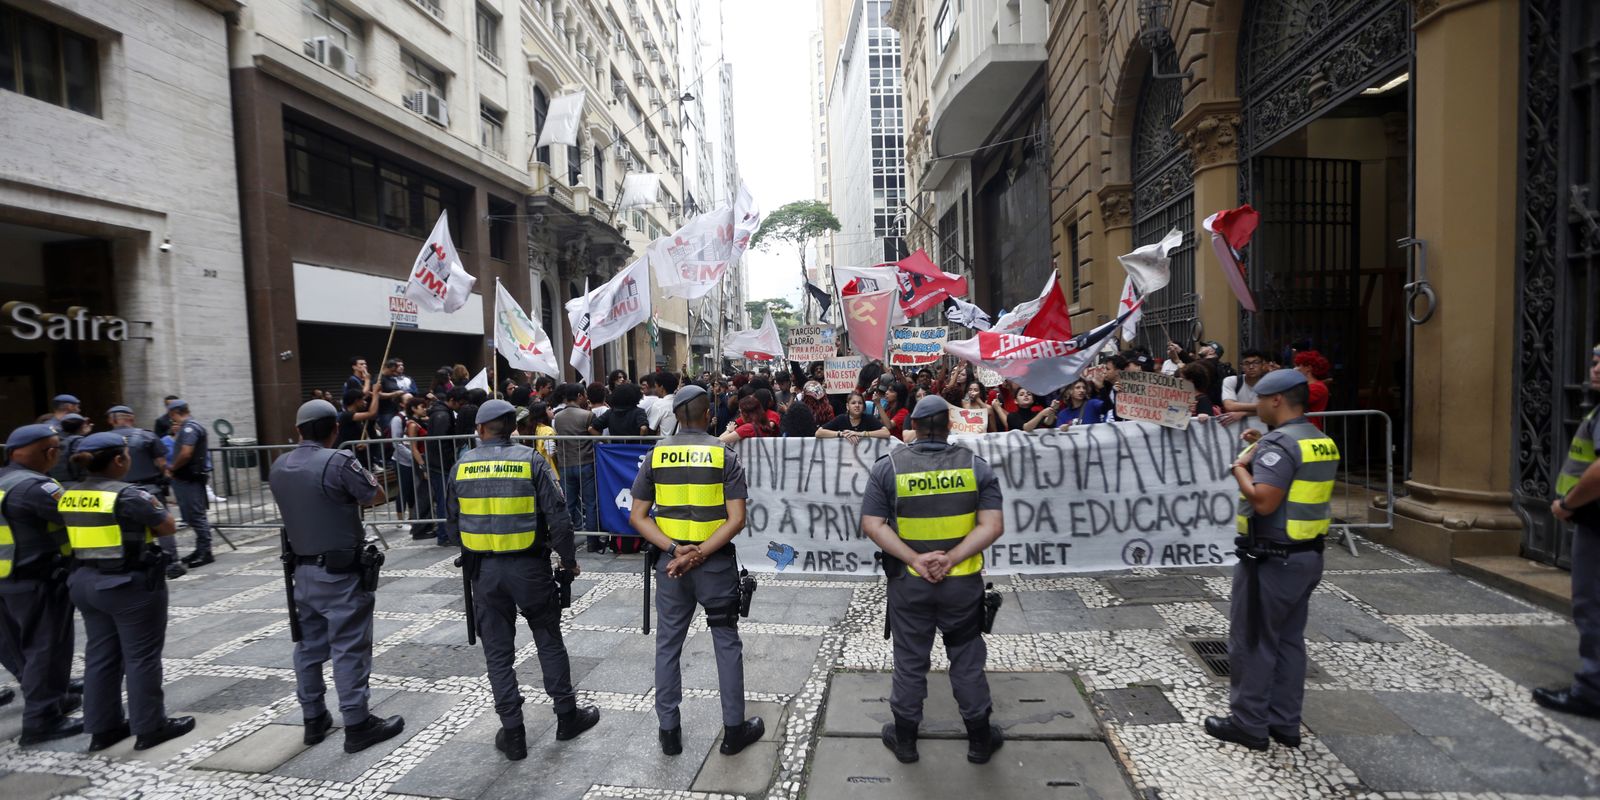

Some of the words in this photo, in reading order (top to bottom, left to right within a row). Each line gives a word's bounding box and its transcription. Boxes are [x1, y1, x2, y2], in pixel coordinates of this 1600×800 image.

[390, 297, 416, 313] ALUGA
[11, 301, 129, 341] Safra
[790, 326, 821, 336] TARCÍSIO
[894, 327, 912, 339] NÃO
[790, 335, 815, 346] LADRÃO
[789, 353, 810, 361] MINHA
[825, 360, 845, 370] MINHA
[825, 370, 840, 379] NÃO
[833, 382, 855, 391] VENDA
[1148, 374, 1178, 388] ESCOLA
[1147, 385, 1192, 404] ESTUDANTE
[1129, 406, 1163, 421] ESCOLAS
[951, 422, 984, 434] GOMES
[661, 449, 713, 464] POLÍCIA
[493, 464, 523, 473] MILITAR
[907, 474, 966, 492] POLÍCIA
[60, 495, 100, 508] POLÍCIA
[807, 502, 868, 541] PRIV
[1013, 498, 1059, 534] DA
[1069, 490, 1235, 538] EDUCAÇÃO
